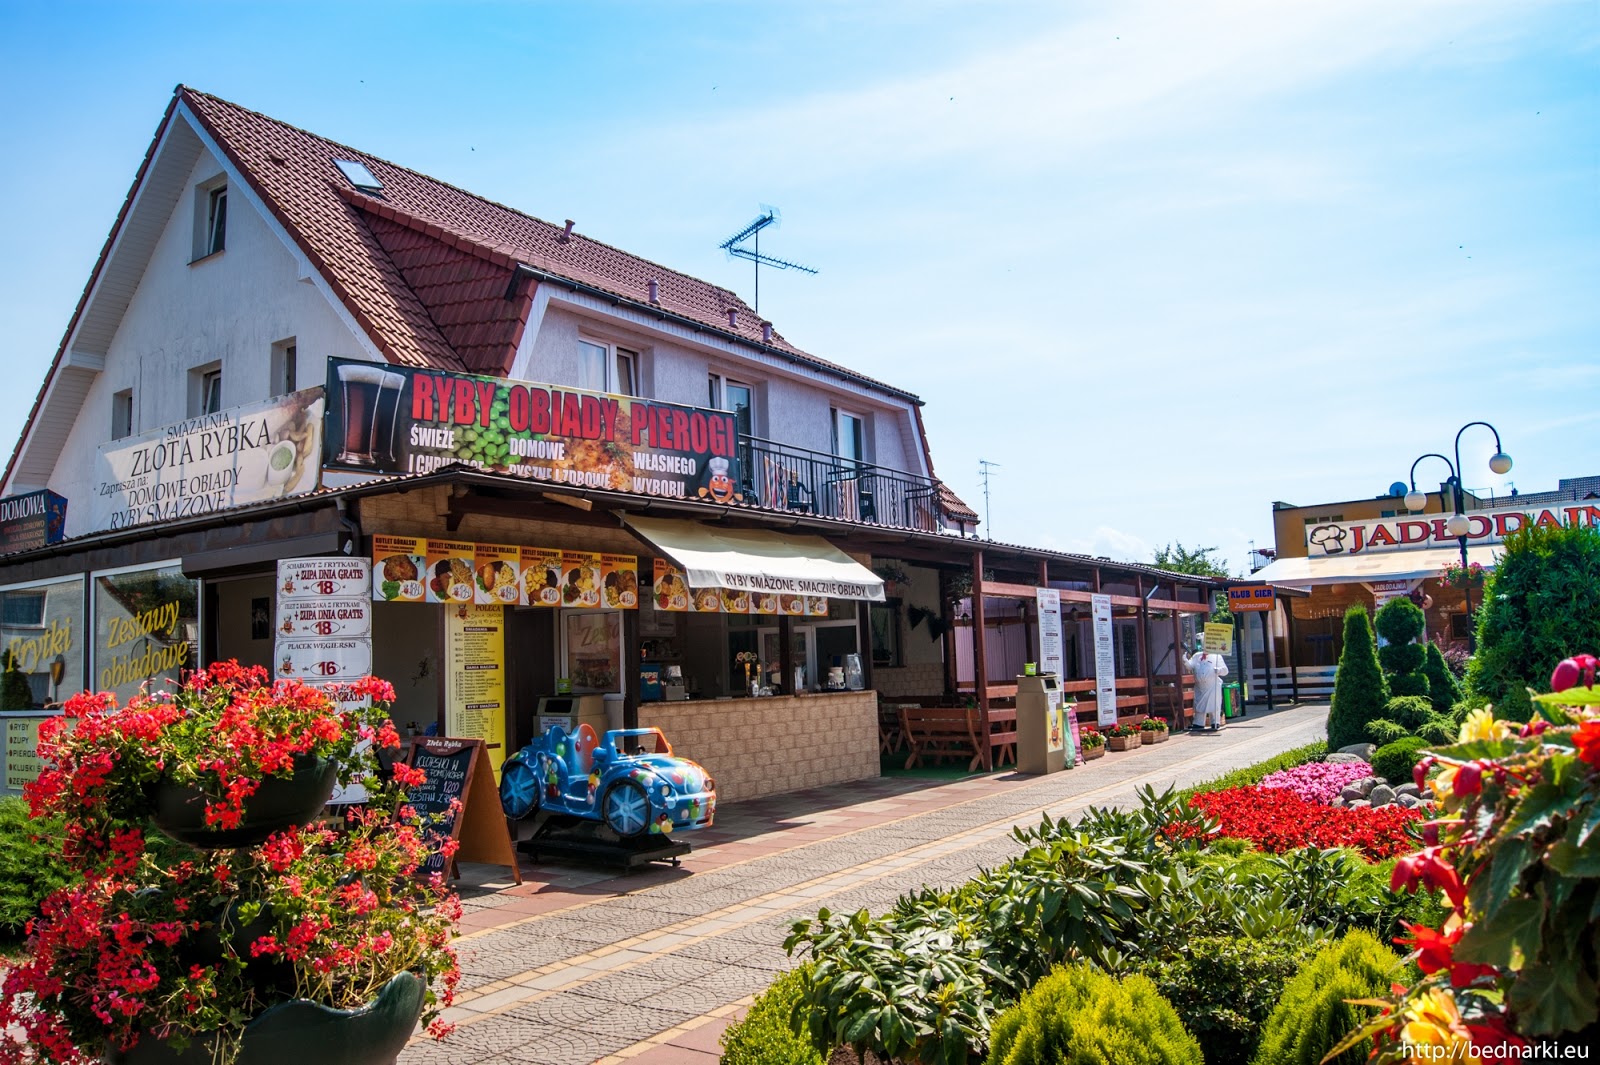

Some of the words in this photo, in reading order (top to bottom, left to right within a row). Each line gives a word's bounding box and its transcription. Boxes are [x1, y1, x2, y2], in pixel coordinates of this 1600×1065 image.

[167, 412, 231, 441] SMAŻALNIA
[412, 373, 496, 428] RYBY
[509, 384, 619, 442] OBIADY
[631, 401, 736, 458] PIEROGI
[130, 438, 195, 477] ZŁOTA
[199, 418, 272, 461] RYBKA
[410, 423, 455, 449] ŚWIEŻE
[509, 437, 565, 461] DOMOWE
[633, 452, 696, 476] WŁASNEGO
[100, 478, 137, 498] Zaprasza
[128, 478, 187, 508] DOMOWE
[189, 466, 243, 494] OBIADY
[632, 476, 685, 497] WYROBU
[1, 494, 46, 522] DOMOWA
[110, 505, 146, 530] RYBY
[146, 489, 226, 522] SMAŻONE
[301, 569, 317, 580] ZUPA
[318, 569, 337, 580] DNIA
[338, 569, 363, 580] GRATIS
[725, 573, 748, 587] RYBY
[750, 576, 797, 593] SMAŻONE,
[799, 581, 836, 594] SMACZNE
[838, 585, 866, 597] OBIADY
[317, 581, 334, 595] 18
[1230, 590, 1250, 599] KLUB
[1255, 589, 1272, 598] GIER
[300, 610, 317, 621] ZUPA
[318, 609, 337, 620] DNIA
[337, 609, 363, 620] GRATIS
[475, 604, 501, 612] POLECA
[107, 600, 180, 649] Zestawy
[315, 621, 332, 635] 18
[6, 617, 73, 675] Frytki
[313, 642, 356, 650] WĘGIERSKI
[101, 642, 188, 690] obiadowe
[318, 661, 337, 675] 16
[13, 723, 29, 731] RYBY
[13, 750, 39, 758] PIEROG
